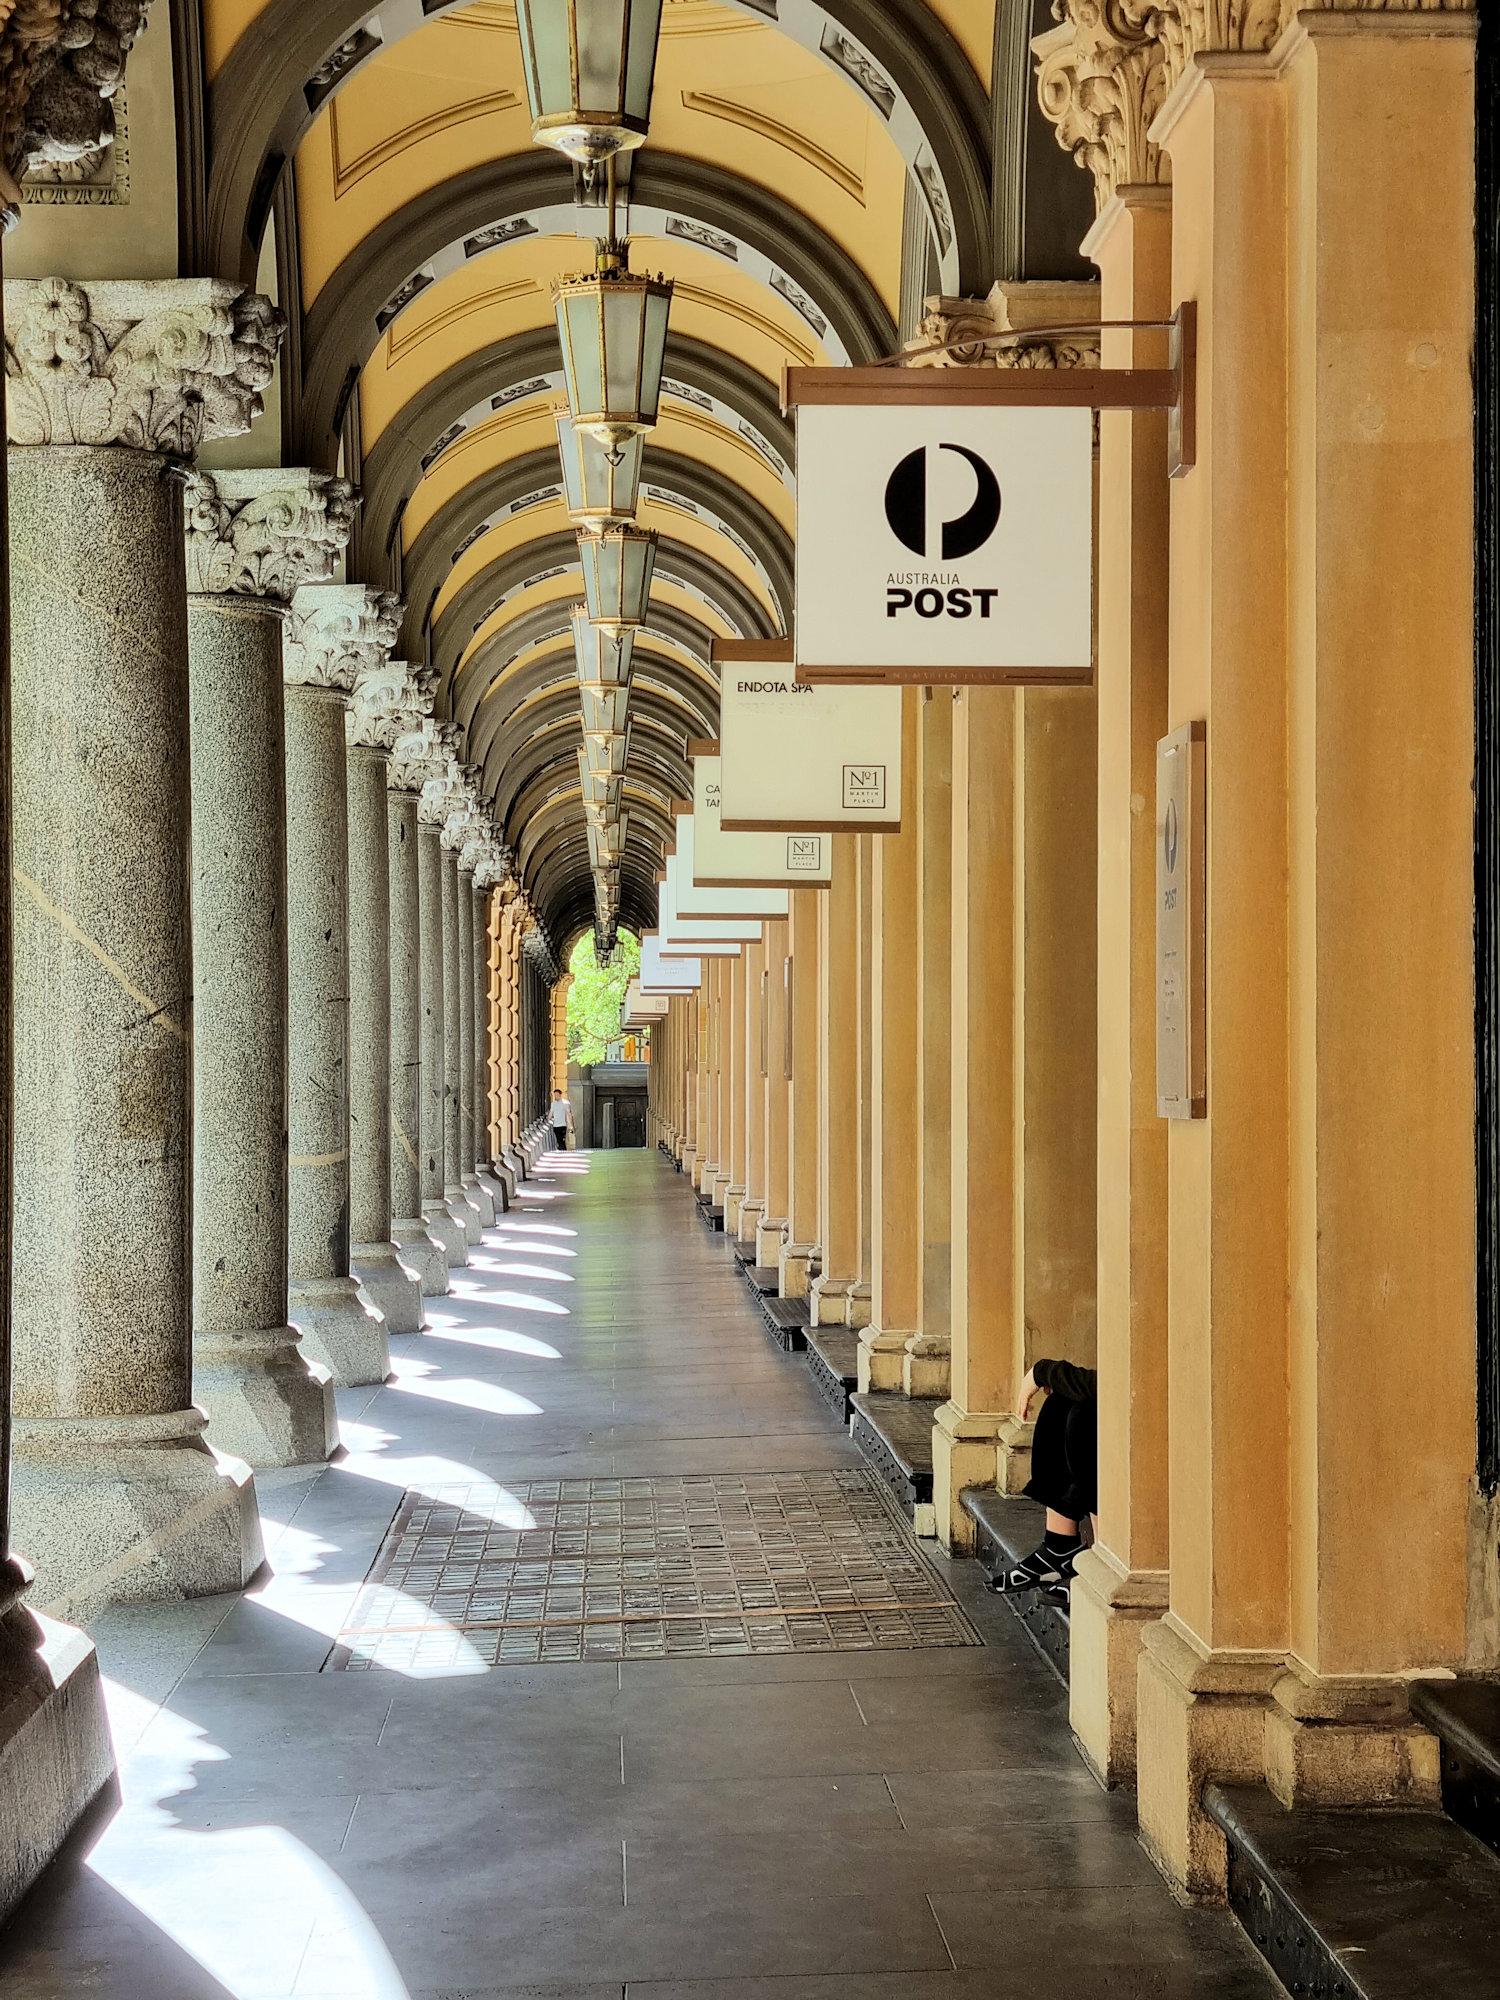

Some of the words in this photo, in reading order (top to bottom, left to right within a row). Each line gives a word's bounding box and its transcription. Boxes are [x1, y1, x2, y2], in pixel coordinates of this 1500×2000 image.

[887, 573, 960, 585] AUSTRALIA
[887, 588, 998, 618] POST
[737, 681, 788, 693] ENDOTA
[791, 683, 814, 694] SPA
